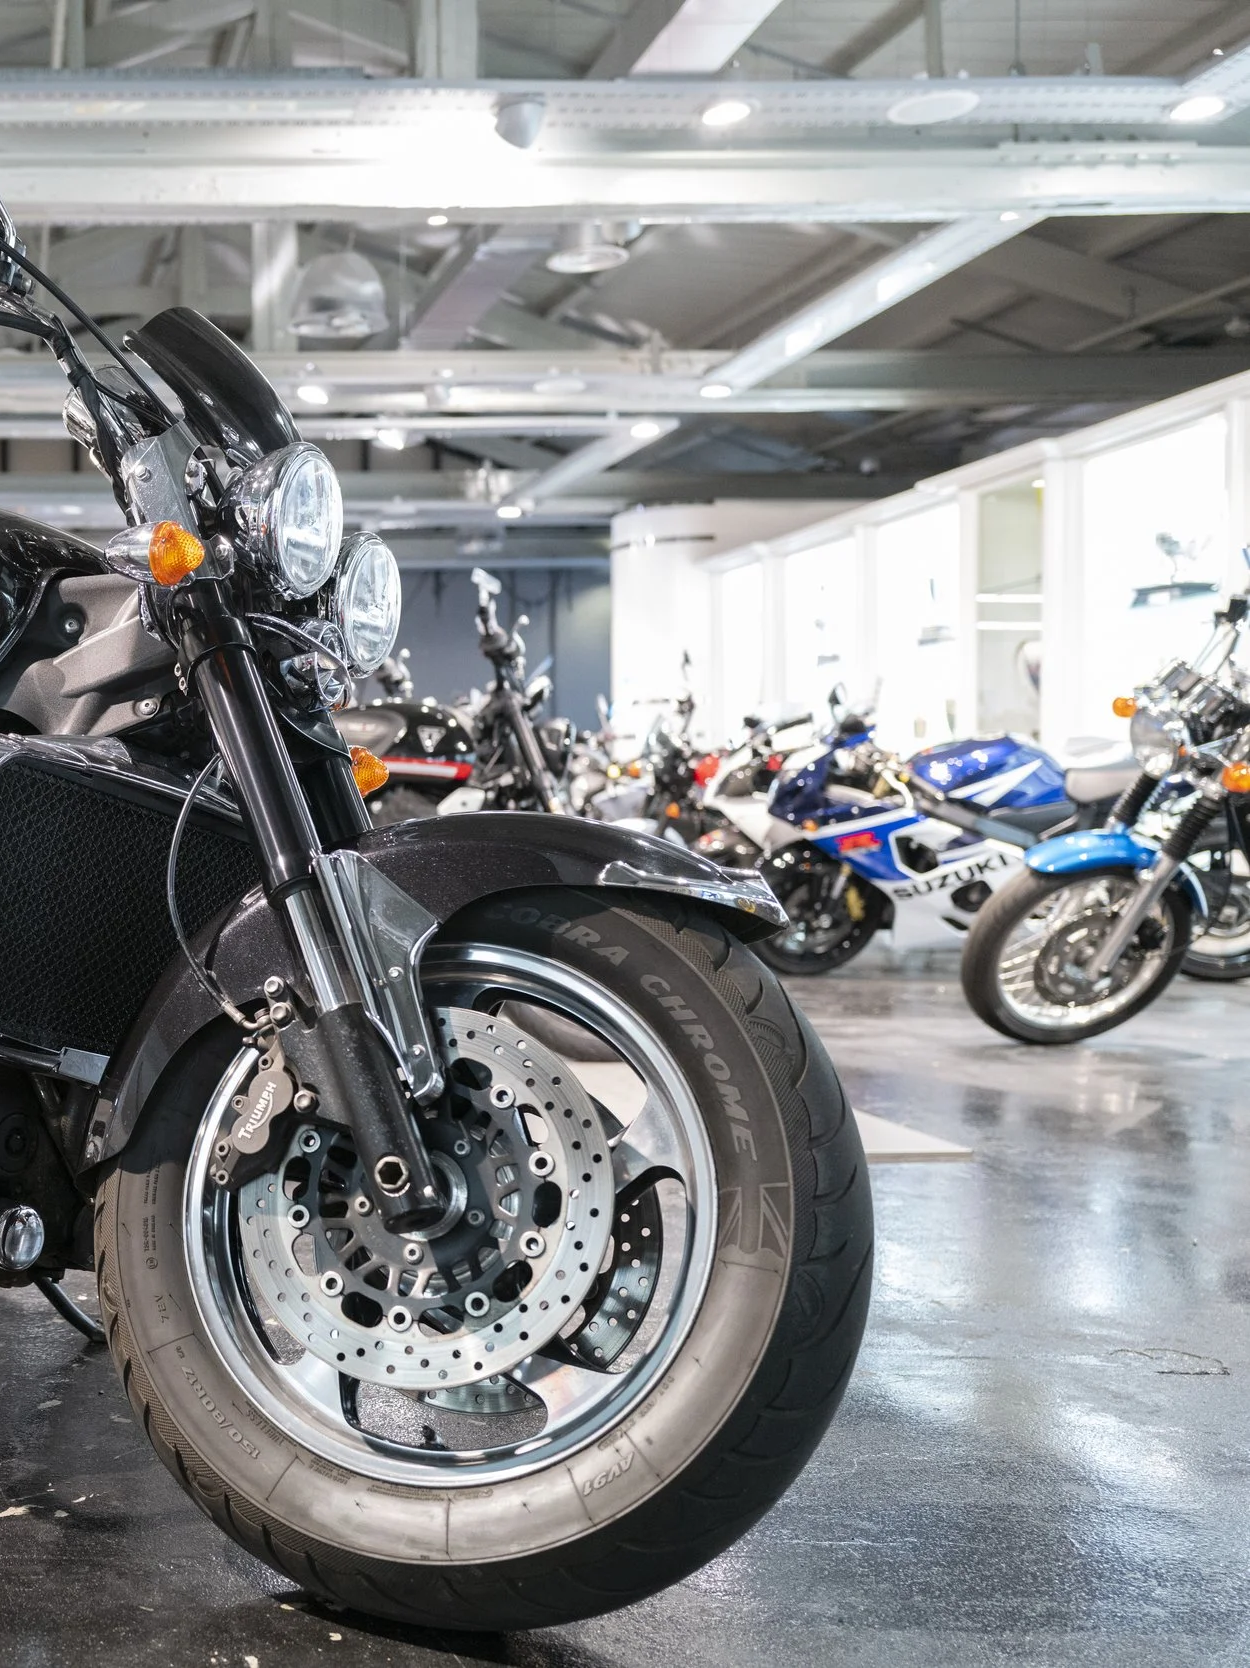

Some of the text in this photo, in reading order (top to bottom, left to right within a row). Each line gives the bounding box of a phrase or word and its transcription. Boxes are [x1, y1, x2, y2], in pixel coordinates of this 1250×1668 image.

[893, 854, 1009, 898] SUZUKI
[485, 903, 757, 1162] COBRA CHROME
[237, 1081, 277, 1139] TRIUMPH
[181, 1365, 260, 1460] 150/80R17
[582, 1450, 634, 1497] AV91
